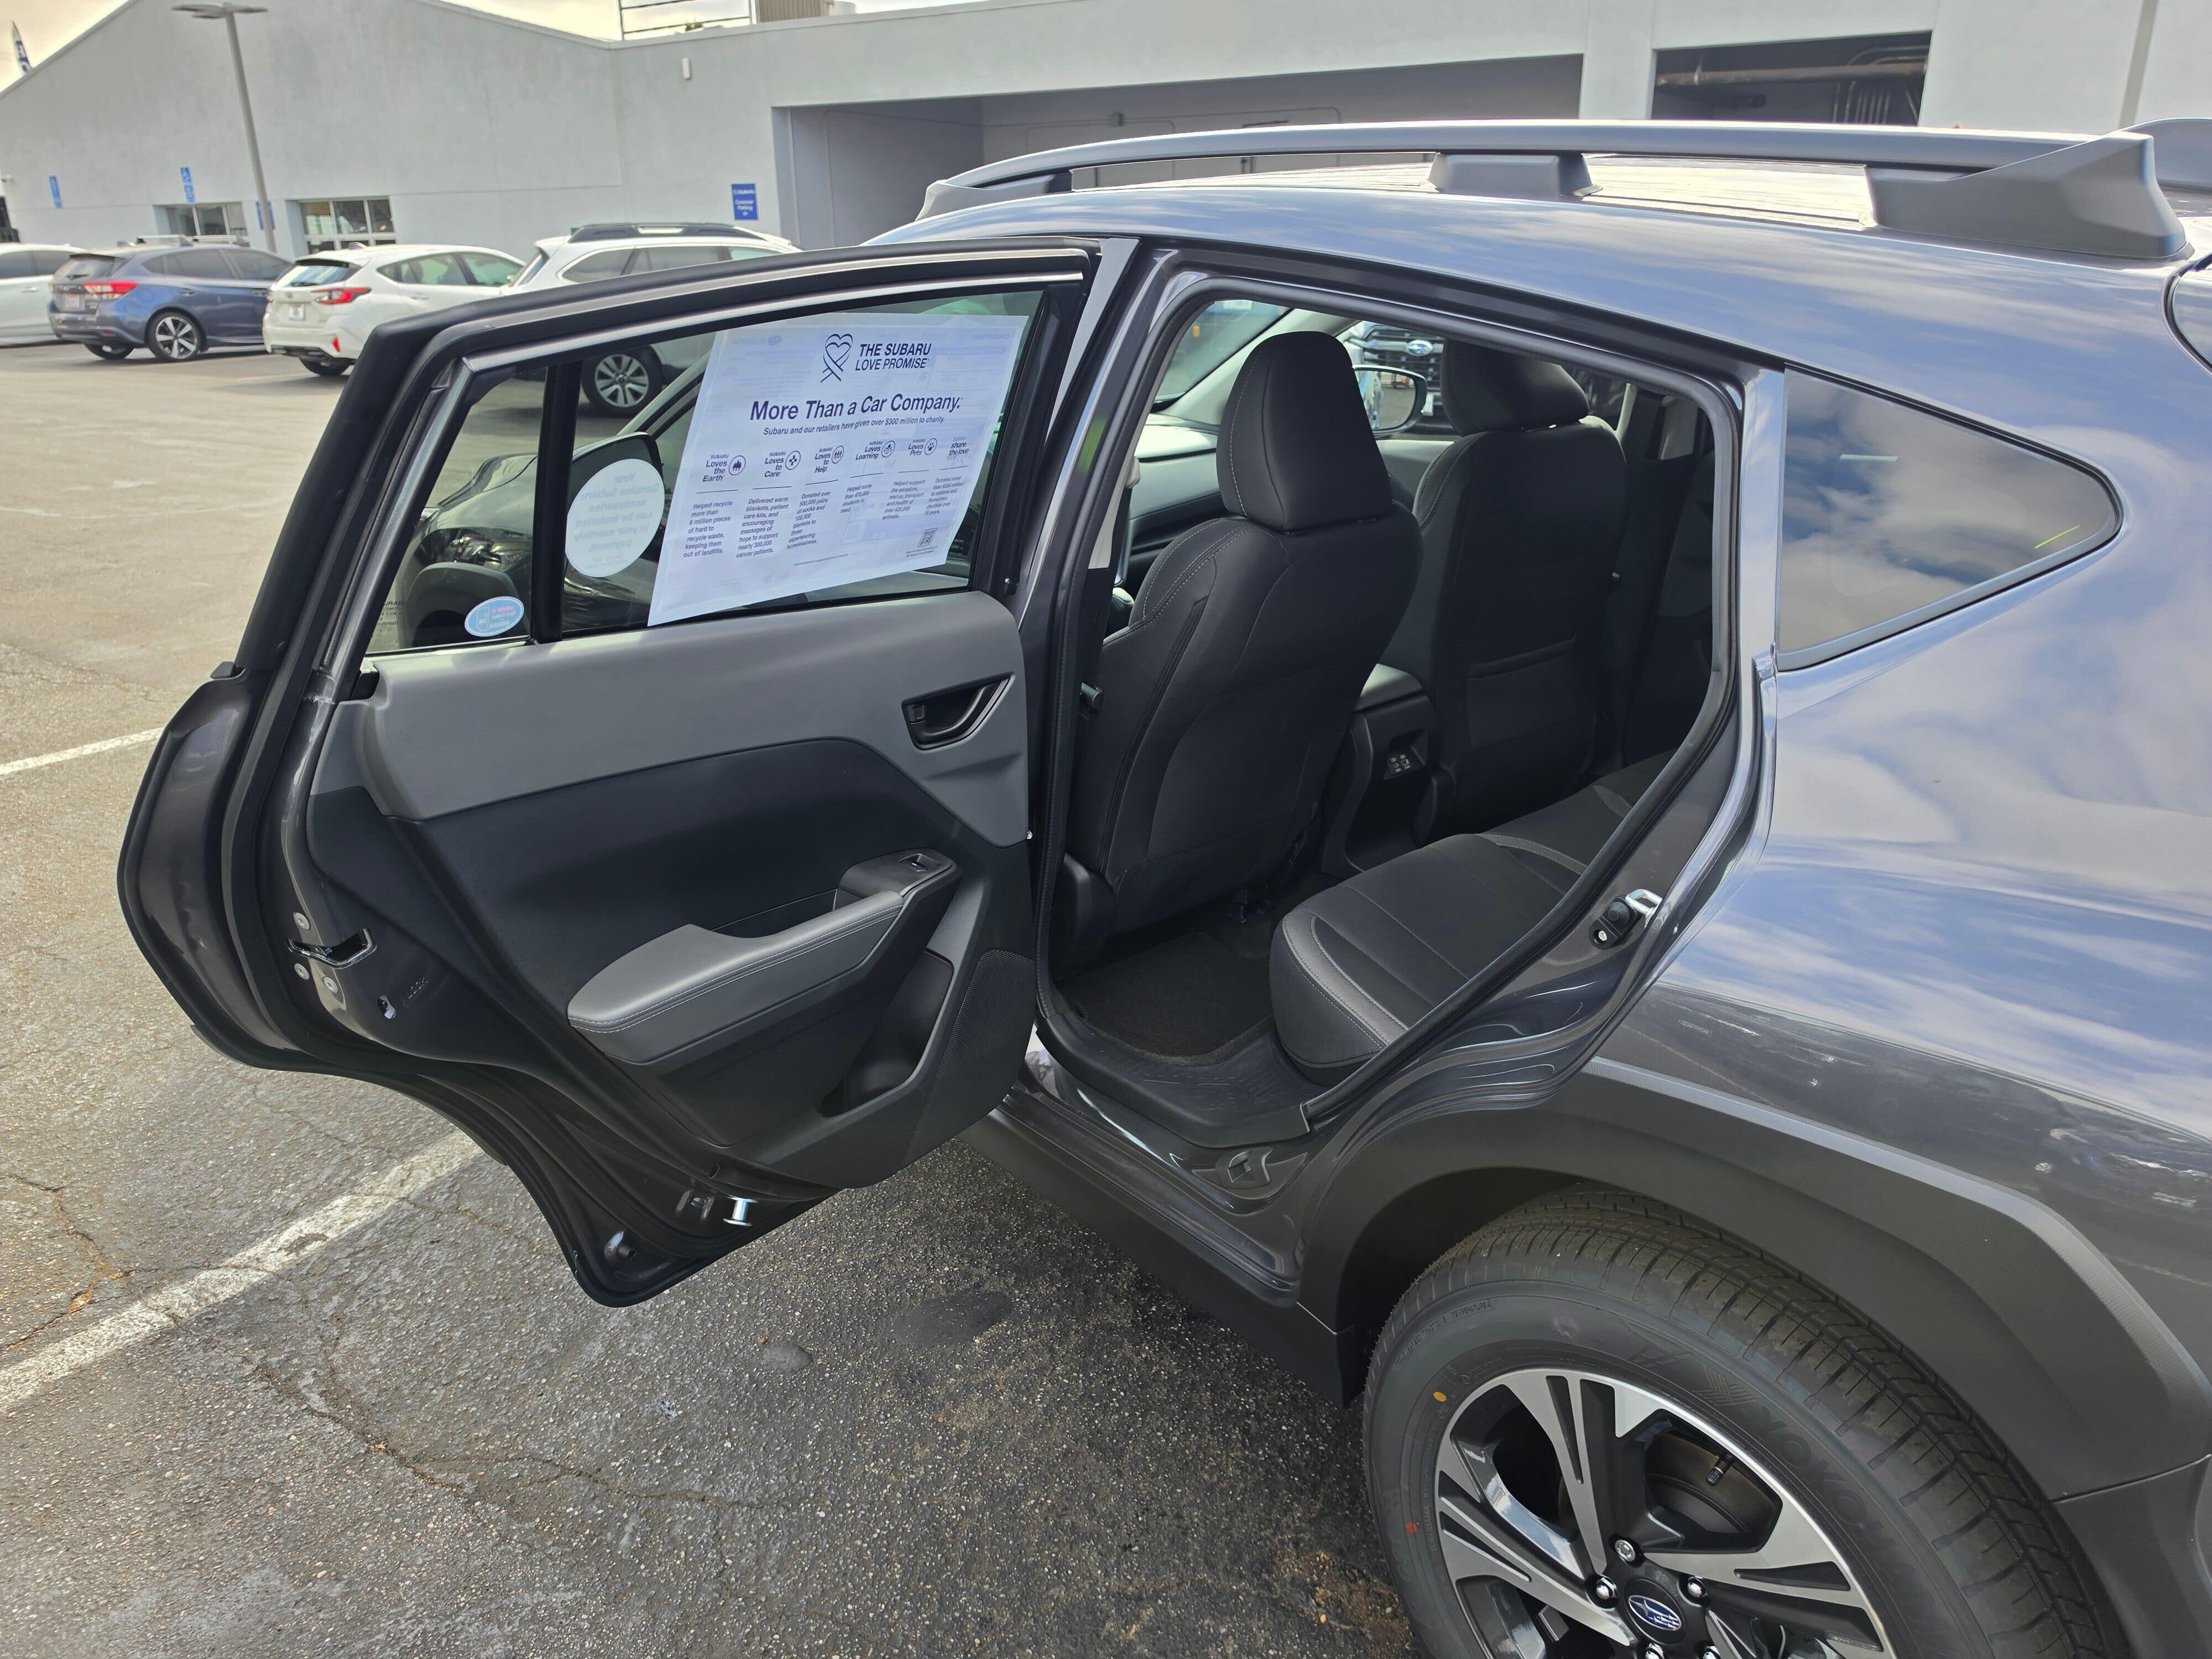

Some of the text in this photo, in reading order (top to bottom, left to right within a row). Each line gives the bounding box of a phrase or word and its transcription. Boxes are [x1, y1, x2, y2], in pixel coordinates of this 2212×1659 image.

[860, 343, 932, 357] THE SUBARU
[855, 358, 927, 371] LOVE PROMISE
[750, 394, 961, 420] More Than a Car Company.
[764, 427, 789, 435] Subaru
[790, 426, 802, 434] and
[816, 424, 840, 432] retailers
[841, 421, 854, 430] have
[854, 419, 869, 429] given
[900, 416, 917, 425] million
[926, 416, 945, 424] charity.
[789, 533, 816, 543] experiencing
[753, 548, 774, 556] patients.
